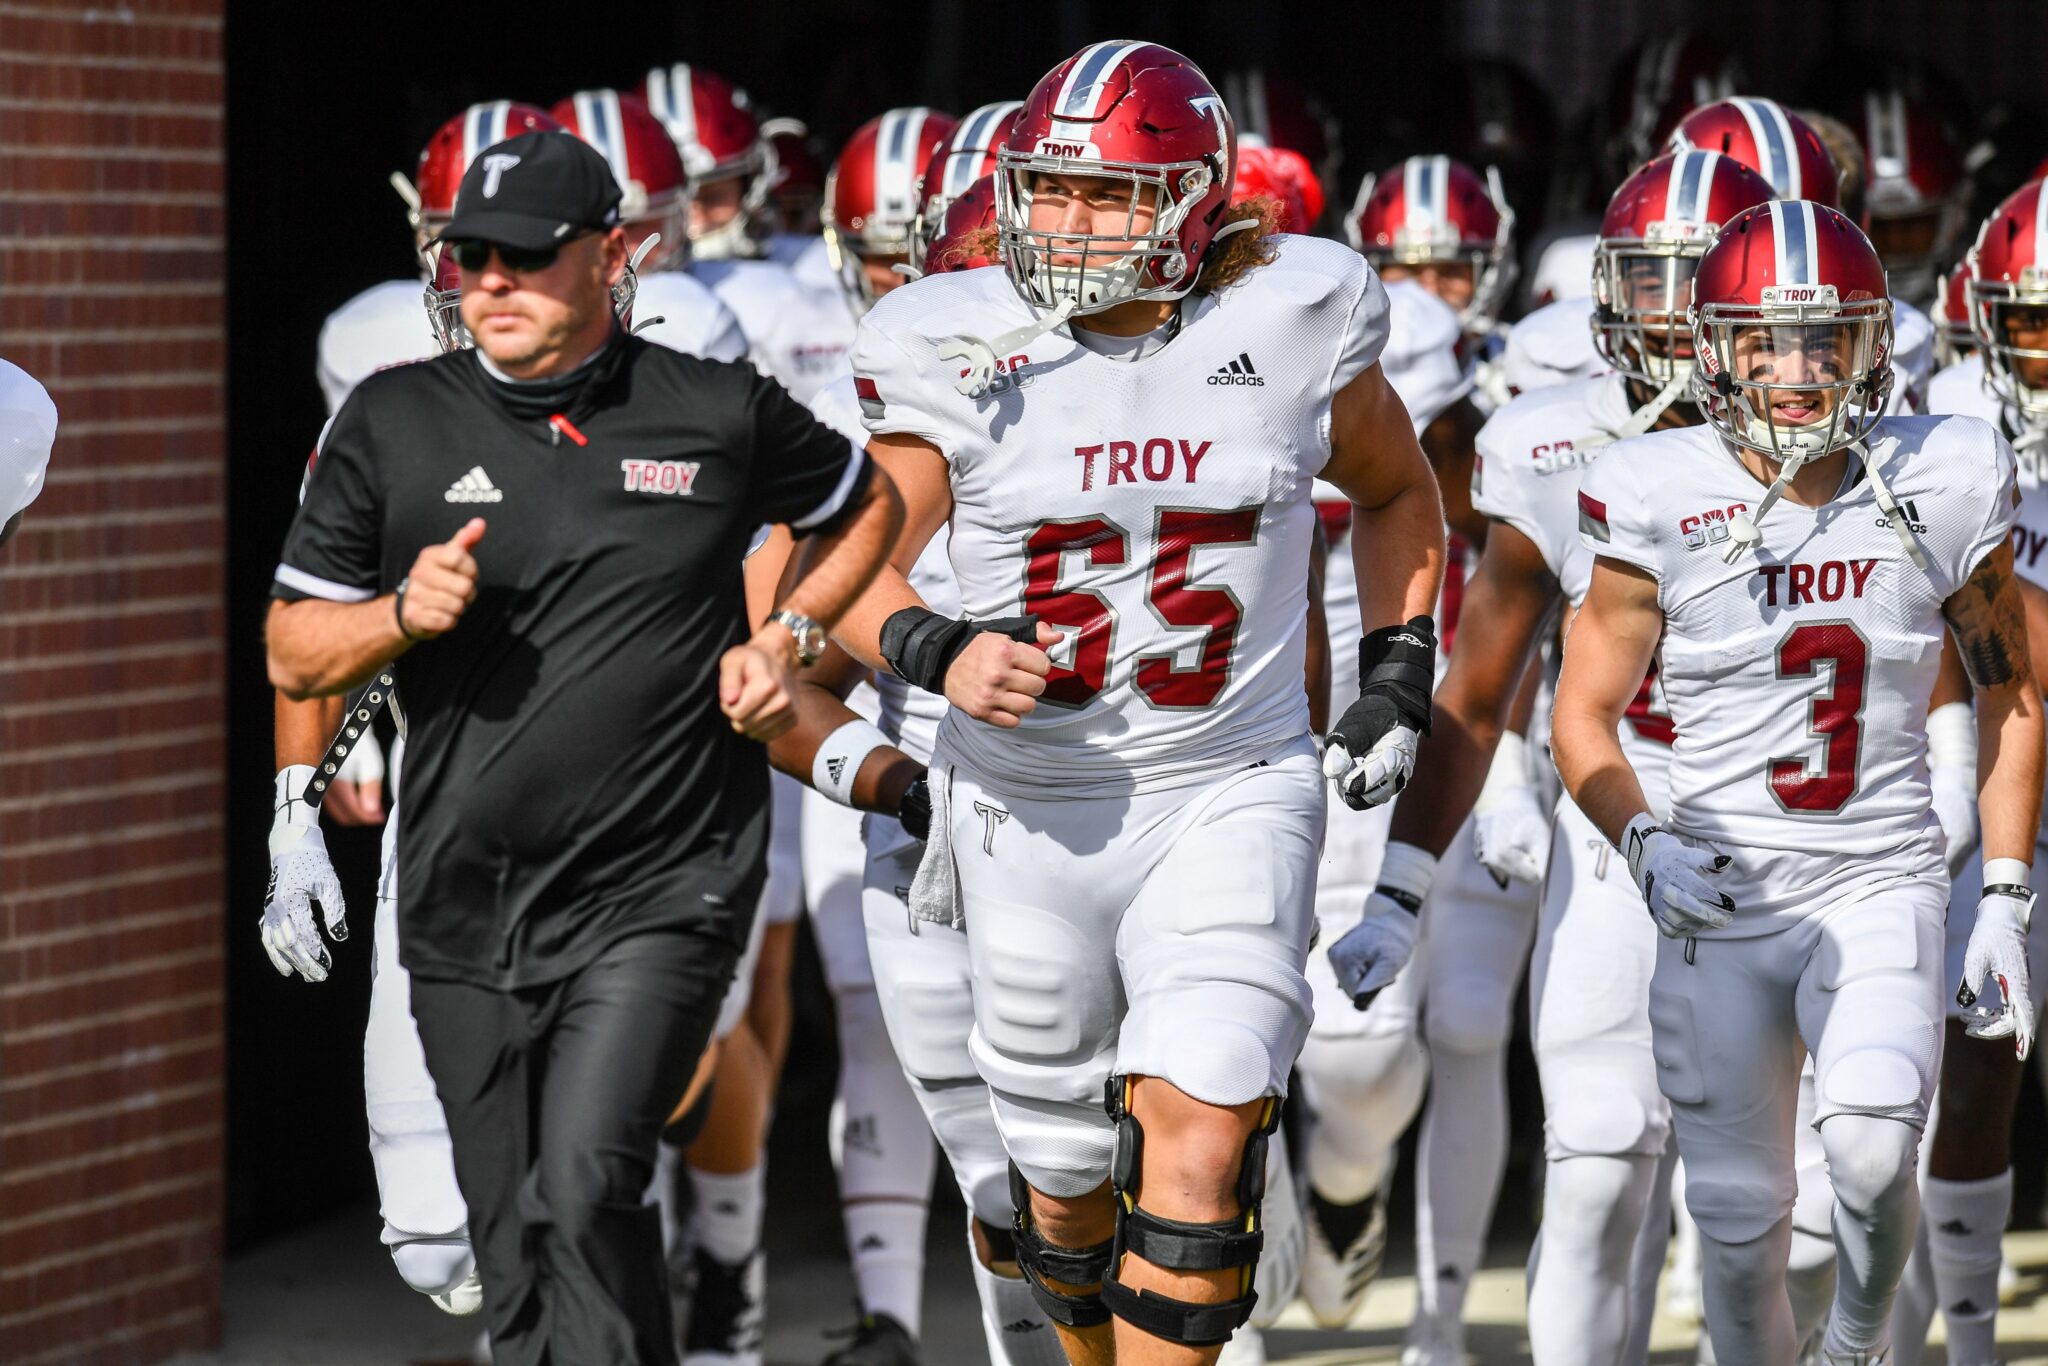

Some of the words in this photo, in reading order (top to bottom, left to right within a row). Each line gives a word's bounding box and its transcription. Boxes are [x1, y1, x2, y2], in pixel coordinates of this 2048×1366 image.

[1042, 143, 1085, 158] TROY
[1784, 289, 1816, 302] TROY
[960, 354, 1036, 401] BC
[1207, 373, 1265, 387] adidas
[621, 459, 701, 495] TROY
[1074, 437, 1213, 492] TROY
[1875, 518, 1928, 534] addas
[1759, 559, 1879, 607] TROY
[1020, 503, 1265, 712] 65
[1766, 618, 1873, 816] 3
